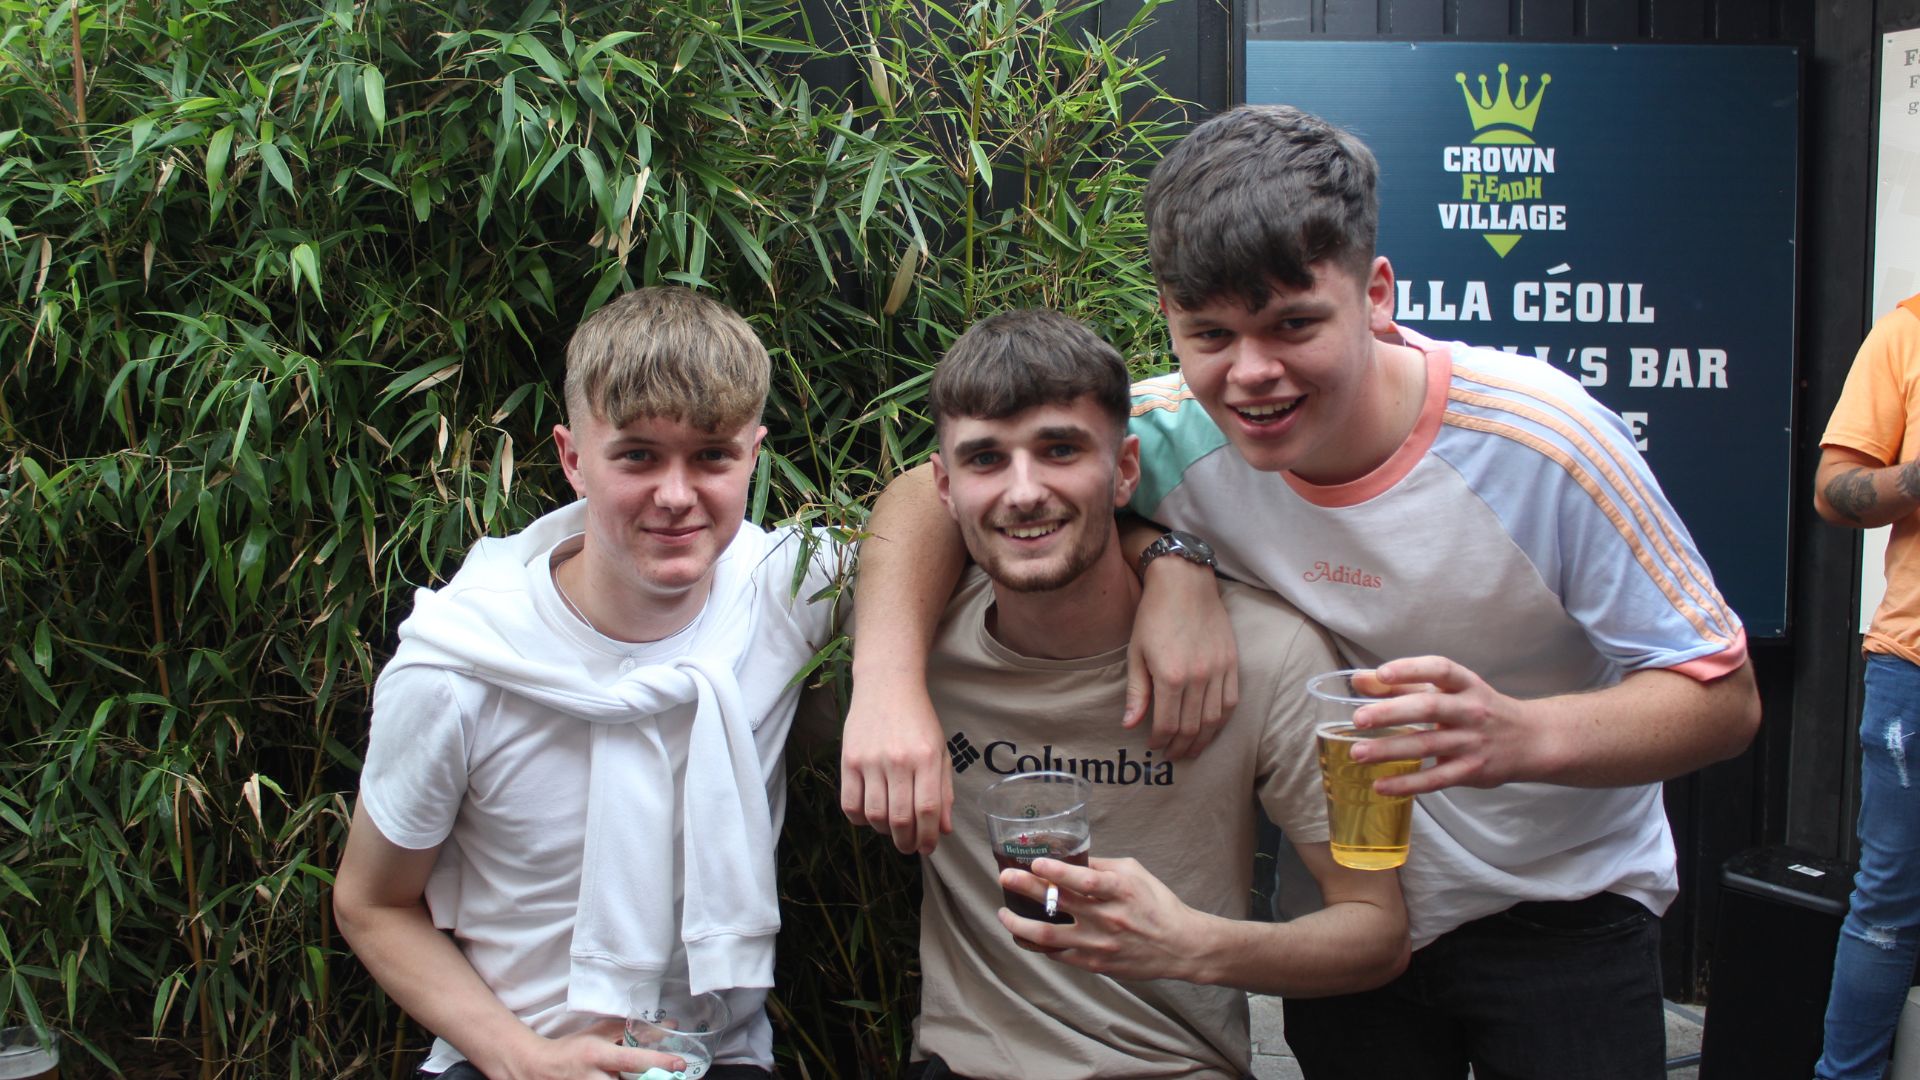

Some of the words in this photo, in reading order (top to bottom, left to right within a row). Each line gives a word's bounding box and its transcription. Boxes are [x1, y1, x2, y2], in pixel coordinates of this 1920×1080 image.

[1443, 146, 1555, 173] CROWN
[1462, 173, 1542, 203] FLEADH
[1438, 203, 1567, 231] VILLAGE
[1396, 280, 1492, 321] LLA
[1513, 262, 1655, 324] CÉOIL
[1628, 347, 1729, 389] BAR
[1303, 560, 1382, 589] Adidas
[983, 741, 1175, 786] Columbia
[1005, 844, 1048, 855] Heineken
